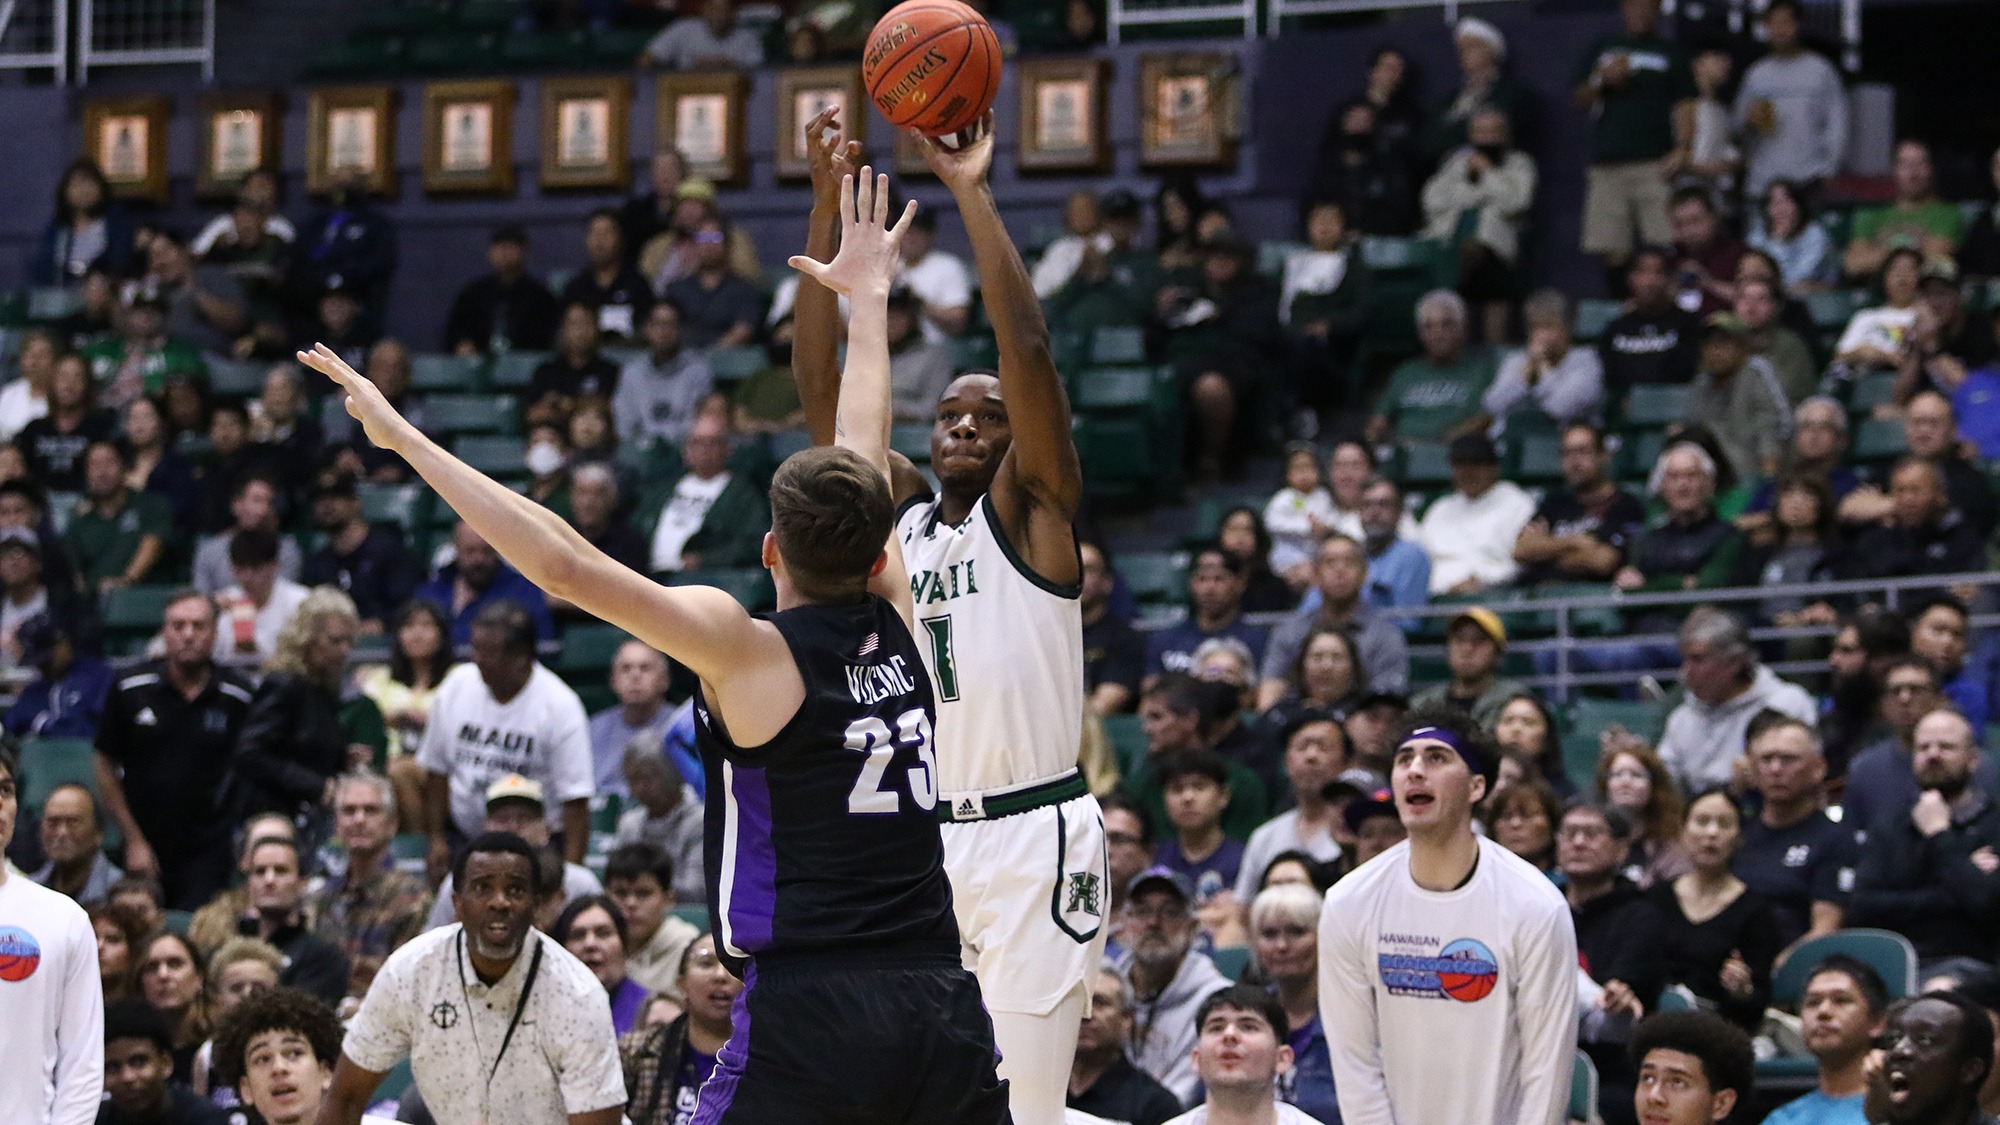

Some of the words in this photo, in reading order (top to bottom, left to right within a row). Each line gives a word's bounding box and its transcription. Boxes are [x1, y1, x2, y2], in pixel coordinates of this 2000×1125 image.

[865, 26, 918, 82] LEGACY
[876, 46, 947, 115] SPALDING
[911, 558, 979, 604] WAI'I
[920, 613, 960, 703] 1
[459, 723, 534, 757] MAUI
[843, 708, 938, 813] 23
[1379, 933, 1440, 947] HAWAIIAN
